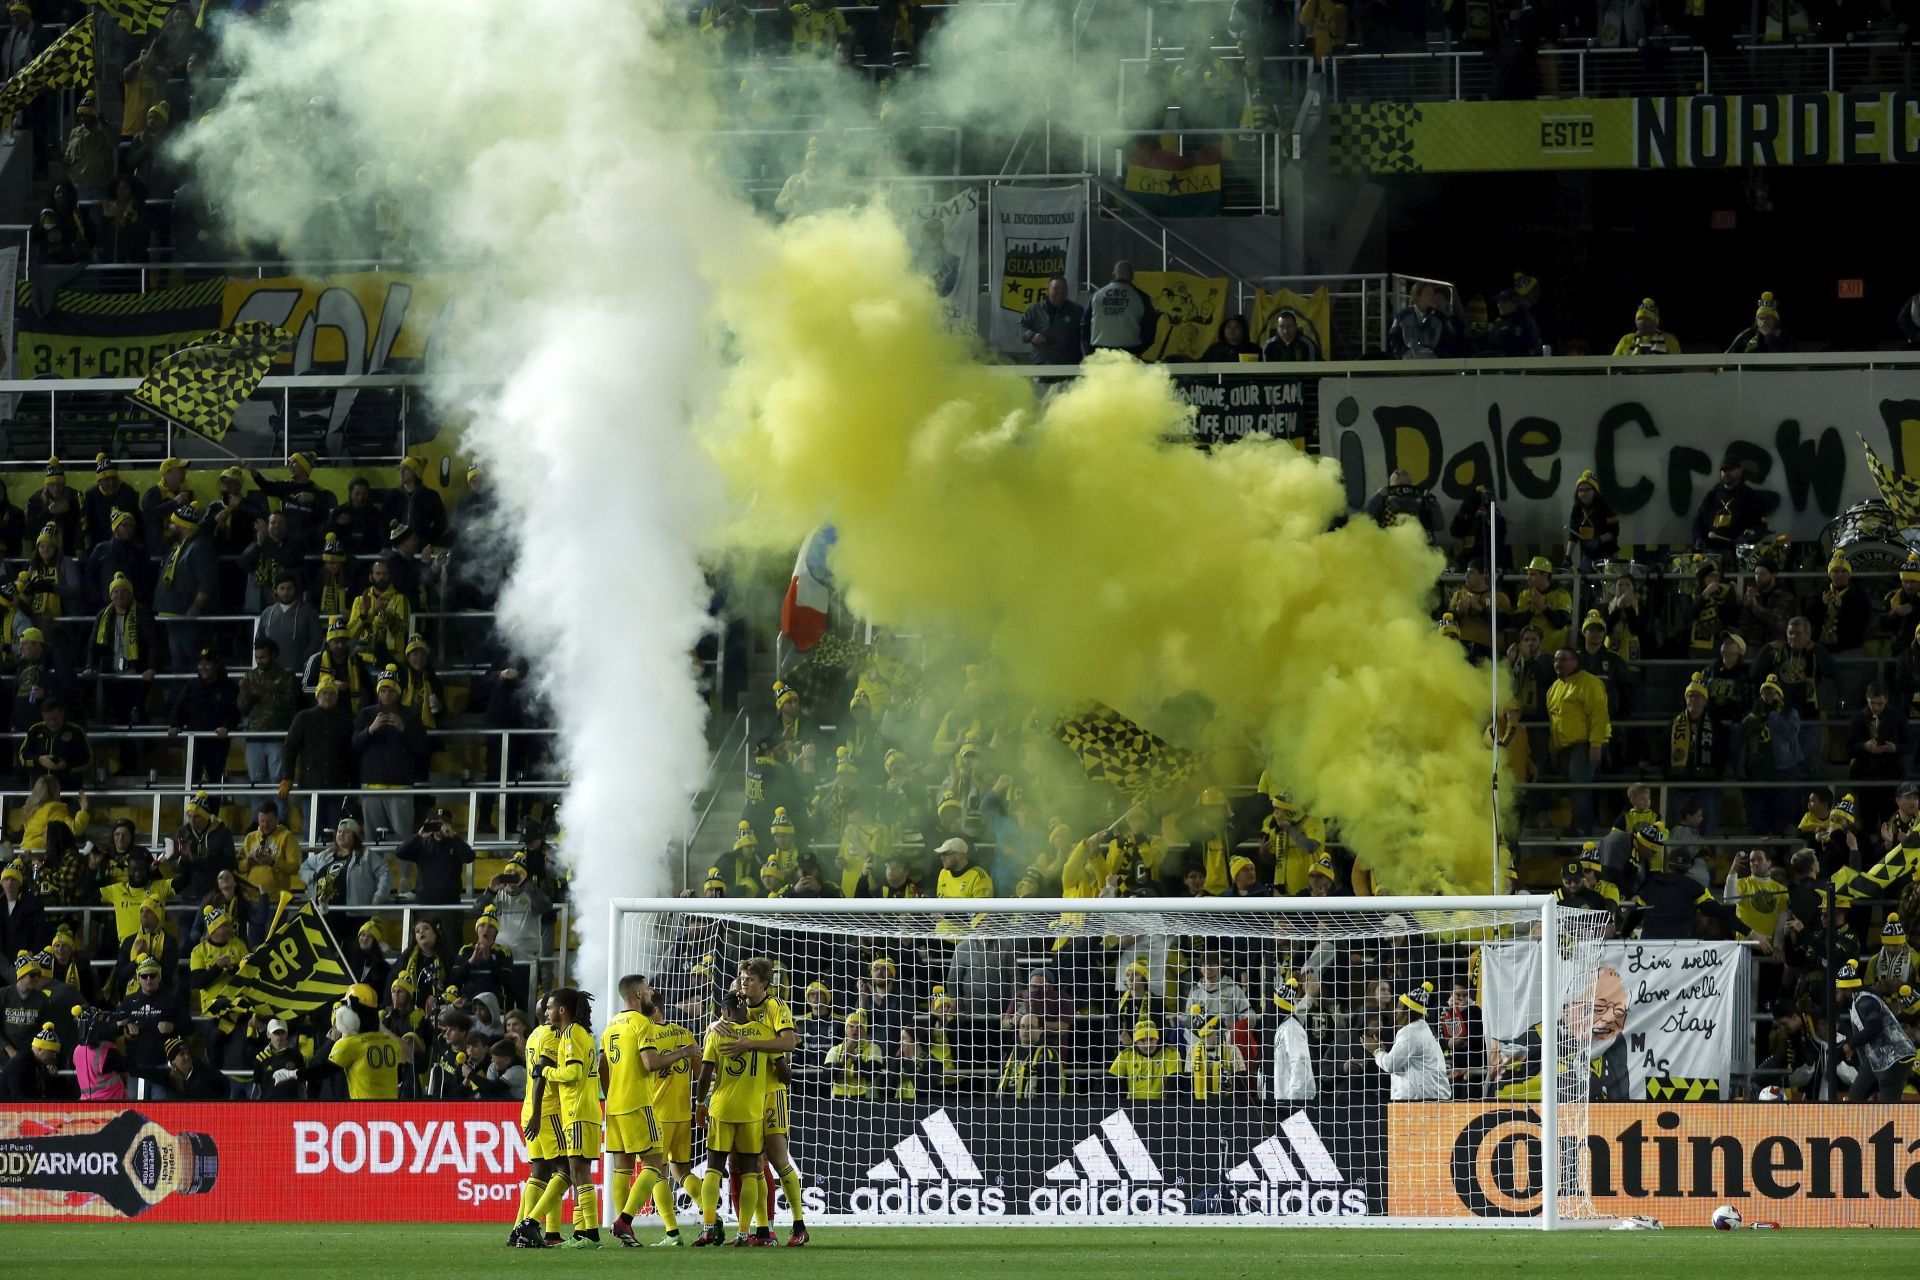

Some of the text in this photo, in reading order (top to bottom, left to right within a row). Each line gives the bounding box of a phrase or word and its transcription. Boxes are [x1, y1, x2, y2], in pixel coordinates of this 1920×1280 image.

[1541, 121, 1594, 147] ESTD
[1007, 258, 1065, 273] GUARDIA
[1230, 386, 1259, 407] OUR
[1264, 383, 1304, 406] TEAM,
[1225, 417, 1253, 436] OUR
[1258, 411, 1298, 438] CREW
[1595, 402, 1846, 517] Crew
[1628, 946, 1671, 972] Live
[1635, 981, 1670, 1004] love
[733, 1028, 762, 1037] REIRA
[1660, 1007, 1716, 1040] stay
[366, 1044, 397, 1070] 00
[609, 1033, 621, 1064] 5
[725, 1047, 758, 1077] 31
[588, 1049, 598, 1078] 2
[293, 1120, 600, 1174] BODYAR
[850, 1179, 1006, 1216] adidas
[1028, 1178, 1187, 1216] adidas
[1231, 1180, 1367, 1217] didas
